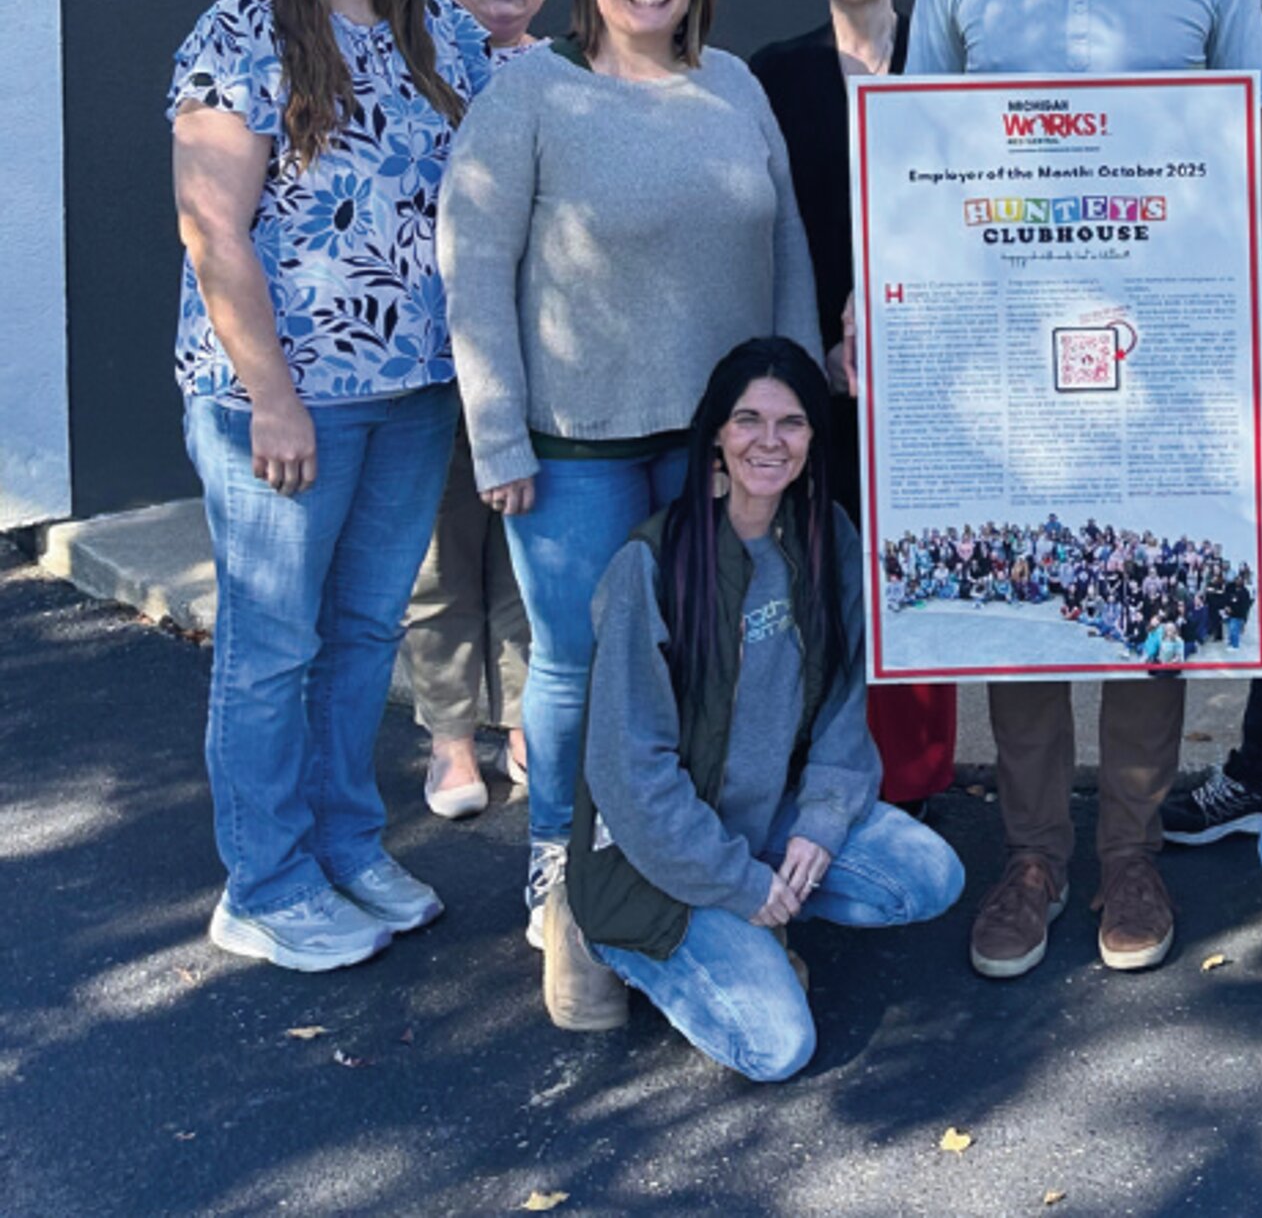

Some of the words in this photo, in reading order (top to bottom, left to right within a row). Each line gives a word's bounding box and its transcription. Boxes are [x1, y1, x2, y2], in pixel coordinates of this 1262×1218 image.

[909, 169, 983, 184] Employer
[986, 166, 1004, 180] of
[1007, 166, 1033, 180] the
[1098, 164, 1163, 178] October
[1166, 162, 1207, 178] 2025
[965, 196, 1166, 225] HUNTEY'S
[983, 226, 1150, 244] CLUBHOUSE
